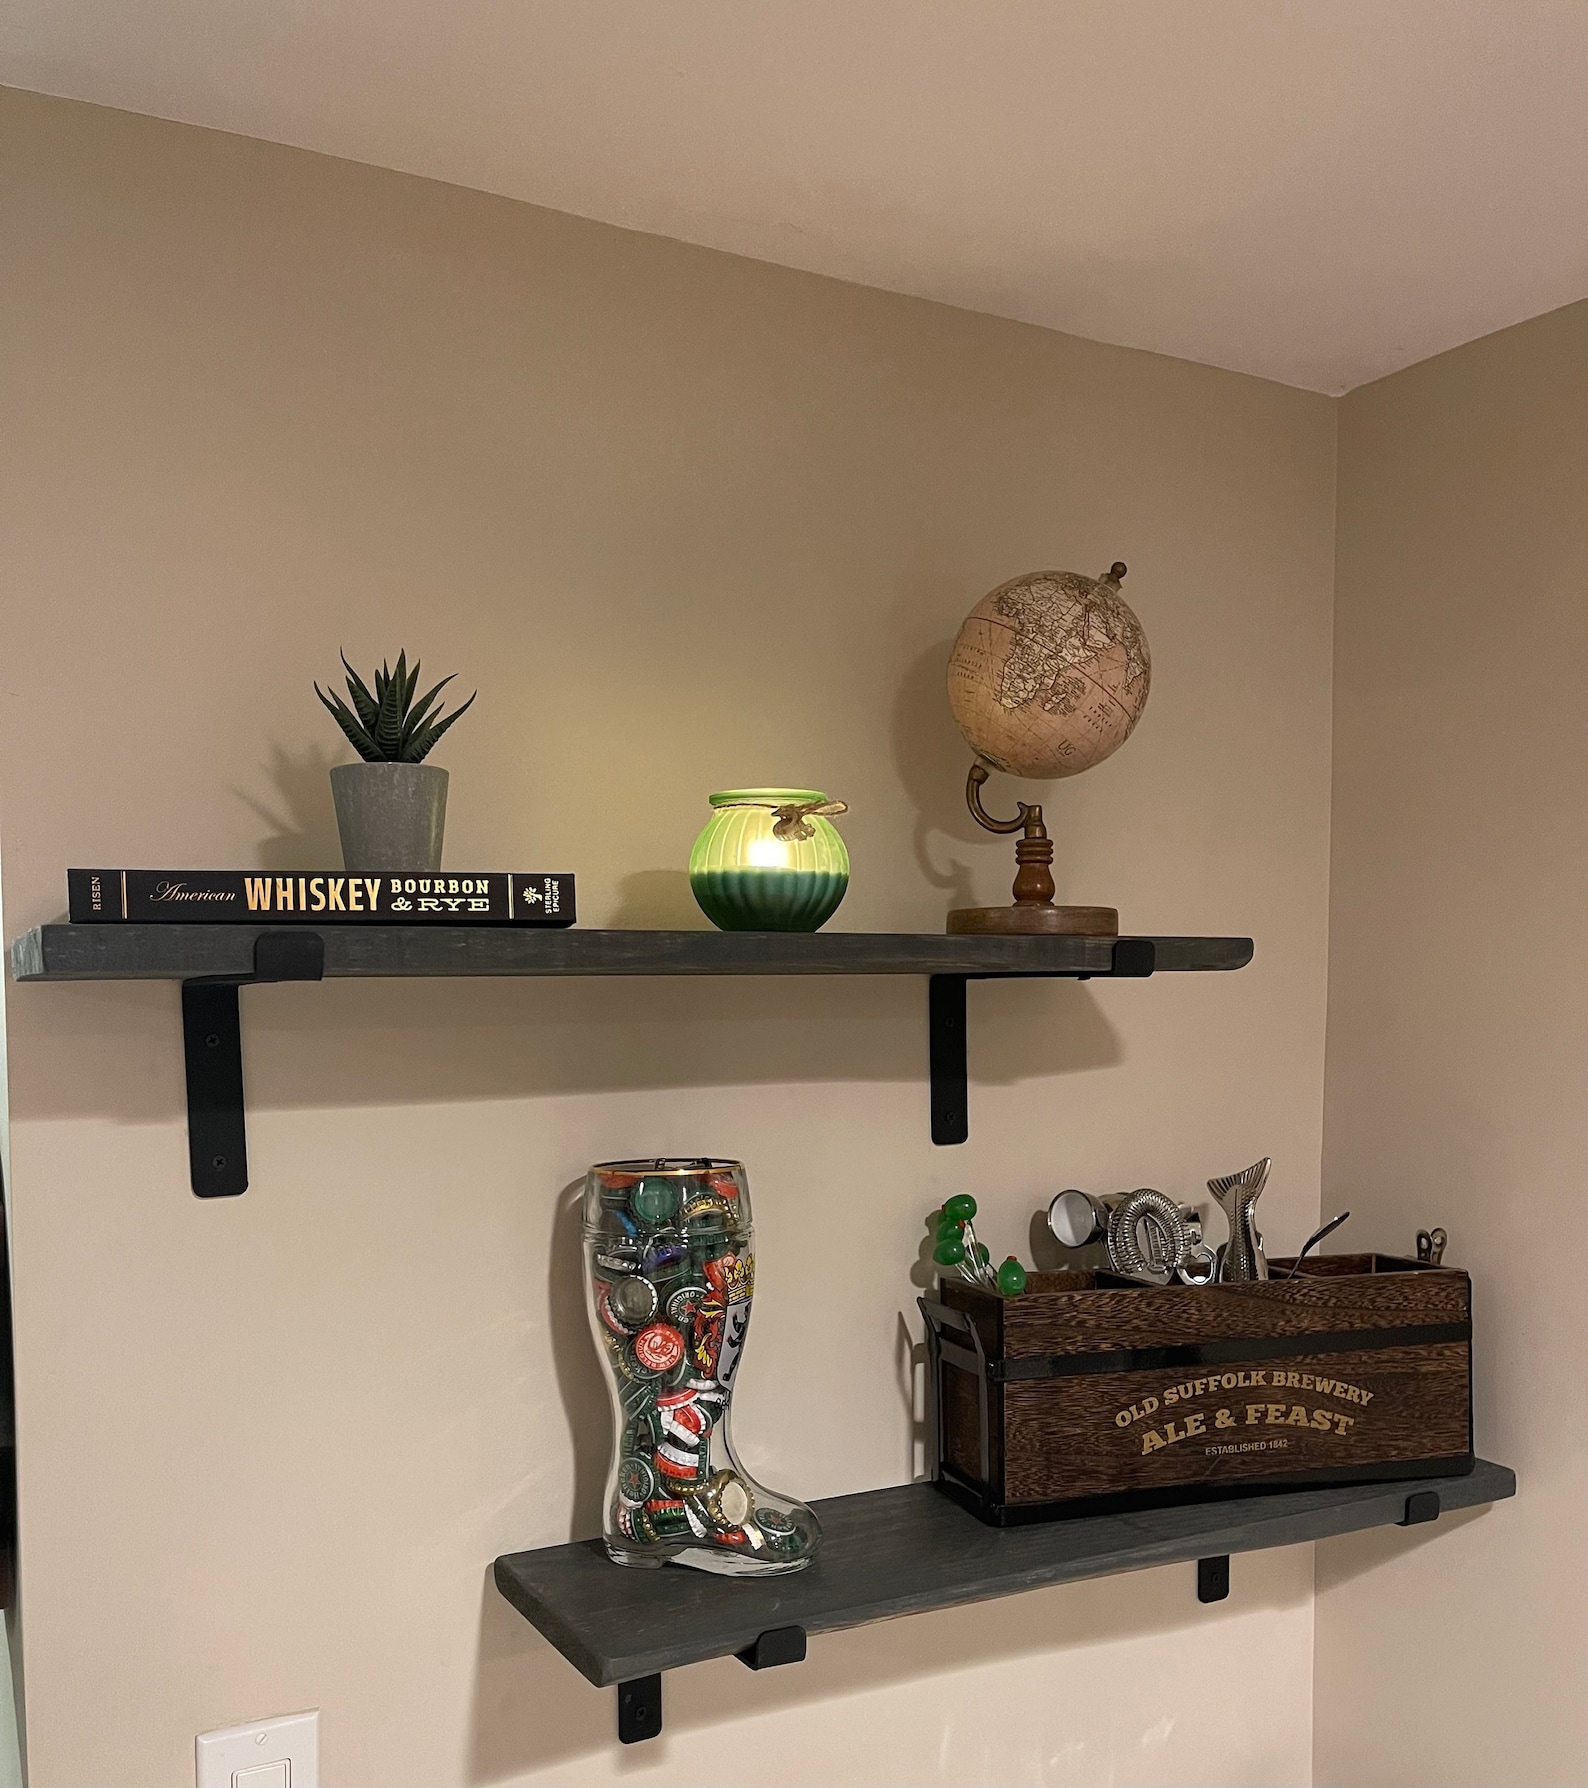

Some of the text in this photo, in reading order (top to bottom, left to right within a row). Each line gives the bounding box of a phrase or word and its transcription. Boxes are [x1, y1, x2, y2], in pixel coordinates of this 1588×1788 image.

[91, 876, 102, 911] RISEN
[149, 877, 382, 911] American WHISKEY
[390, 879, 490, 895] BOURBON
[544, 877, 552, 914] STERLING
[552, 880, 560, 912] EPICURE
[390, 896, 490, 912] & RYE
[670, 1290, 696, 1315] ORIGINAL
[658, 1355, 676, 1368] NEW
[1115, 1370, 1375, 1428] OLD SUFFOLK BREWERY
[1141, 1403, 1355, 1456] ALE & FEAST
[1205, 1438, 1289, 1456] ESTABLISHED 1842
